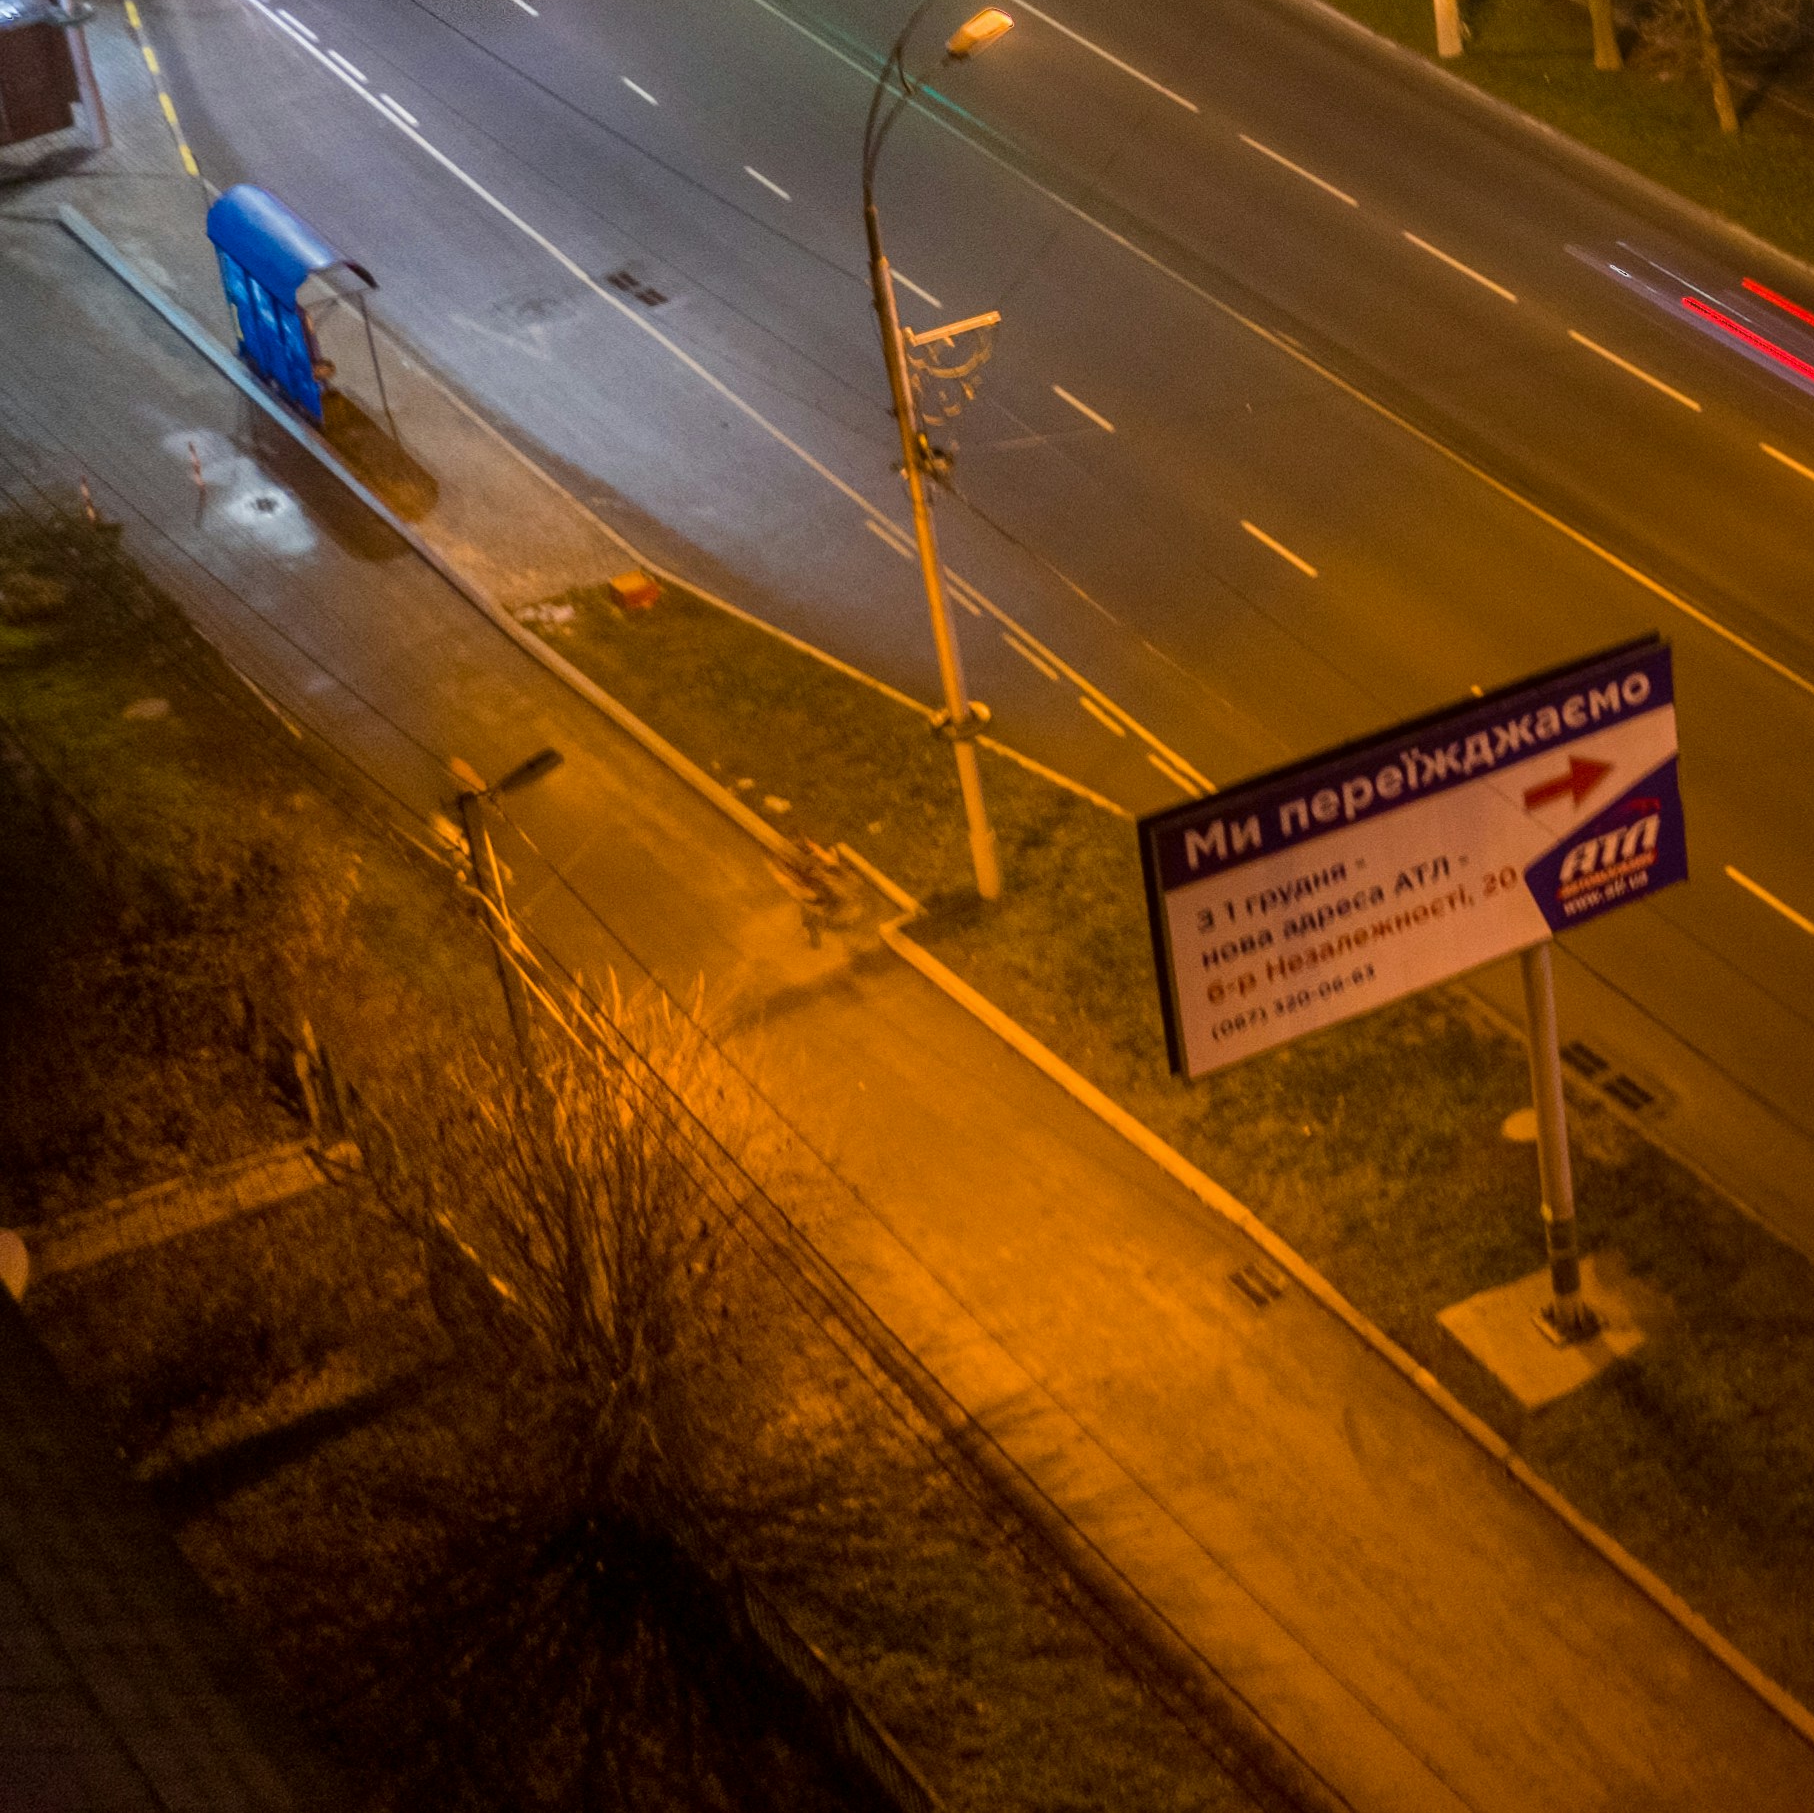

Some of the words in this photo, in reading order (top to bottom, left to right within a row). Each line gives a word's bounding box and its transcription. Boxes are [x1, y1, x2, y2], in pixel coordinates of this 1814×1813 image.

[1184, 813, 1264, 872] Ми
[1279, 671, 1652, 838] переїжджаємо
[1482, 864, 1518, 898] 20
[1558, 813, 1662, 884] АТЛ
[1201, 928, 1274, 971] нова
[1283, 884, 1385, 940] адреса
[1394, 854, 1450, 897] АТЛ
[1246, 861, 1348, 916] грудня
